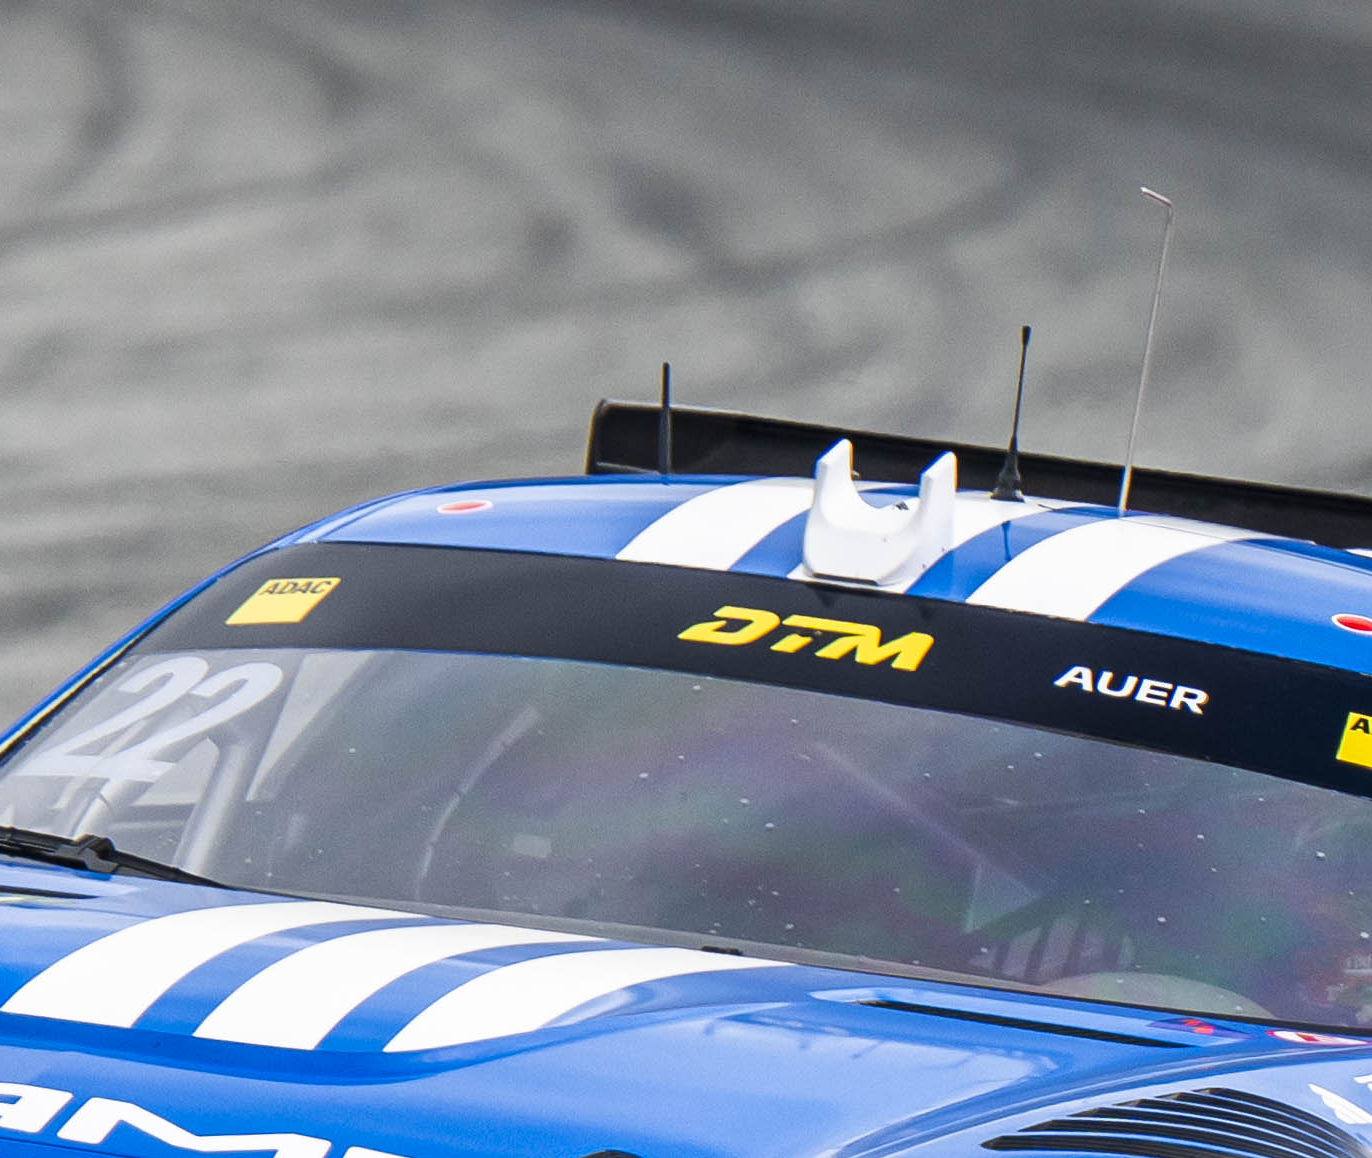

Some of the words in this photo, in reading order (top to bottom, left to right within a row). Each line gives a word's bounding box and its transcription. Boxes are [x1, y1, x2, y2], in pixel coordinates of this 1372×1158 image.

[258, 580, 333, 597] ADAC
[677, 605, 935, 672] DTM
[9, 656, 284, 783] 22
[1053, 666, 1210, 715] AUER
